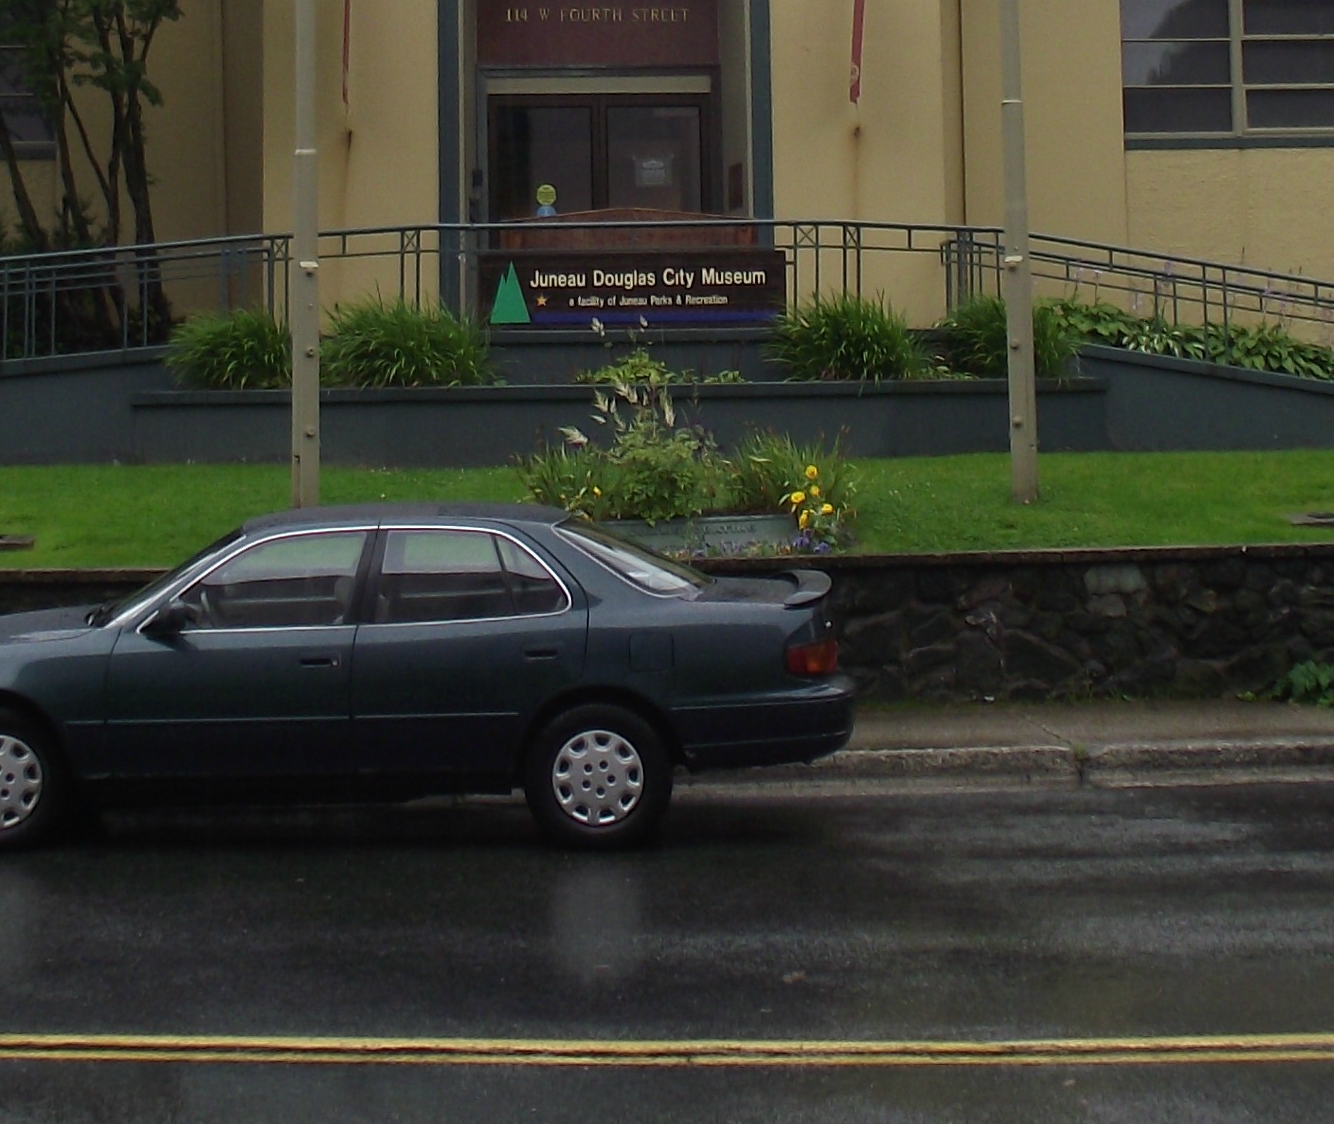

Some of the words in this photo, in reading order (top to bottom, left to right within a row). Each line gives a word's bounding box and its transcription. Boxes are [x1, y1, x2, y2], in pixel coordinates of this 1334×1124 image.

[505, 8, 528, 22] 114
[539, 8, 550, 21] W
[560, 8, 623, 22] FOURTH
[632, 8, 690, 22] STREET
[529, 269, 586, 289] Juneau
[592, 269, 656, 290] Douglas
[662, 267, 694, 289] City
[701, 266, 766, 286] Museum
[577, 295, 604, 308] facility
[607, 295, 616, 306] of
[619, 295, 648, 306] Juneau
[650, 294, 673, 306] Parks
[685, 294, 729, 306] Recreation
